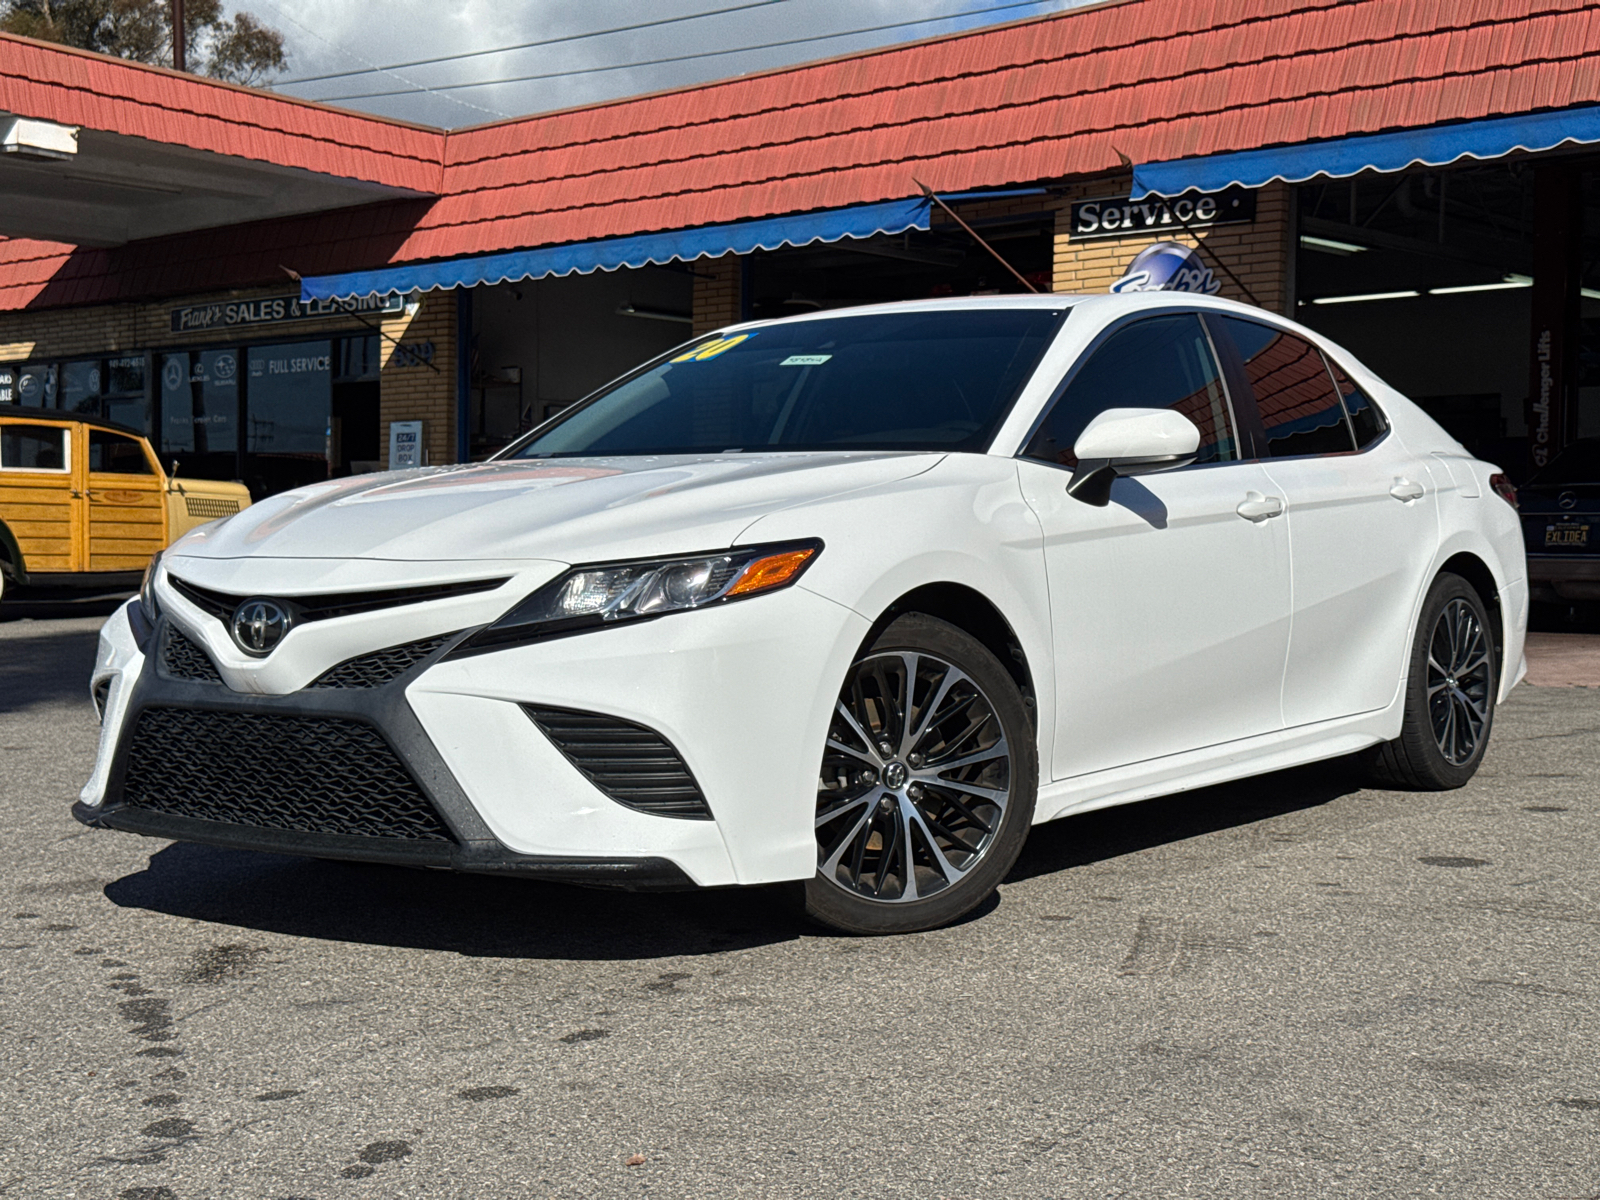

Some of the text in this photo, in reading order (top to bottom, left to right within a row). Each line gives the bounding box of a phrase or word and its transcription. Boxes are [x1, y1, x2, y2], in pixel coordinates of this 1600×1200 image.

[1077, 196, 1217, 233] Service
[179, 294, 390, 330] Frank's SALES & LEASING
[269, 356, 330, 375] FULL SERVICE
[397, 434, 416, 443] 24/7
[397, 444, 415, 453] DROP
[398, 453, 413, 463] BOX
